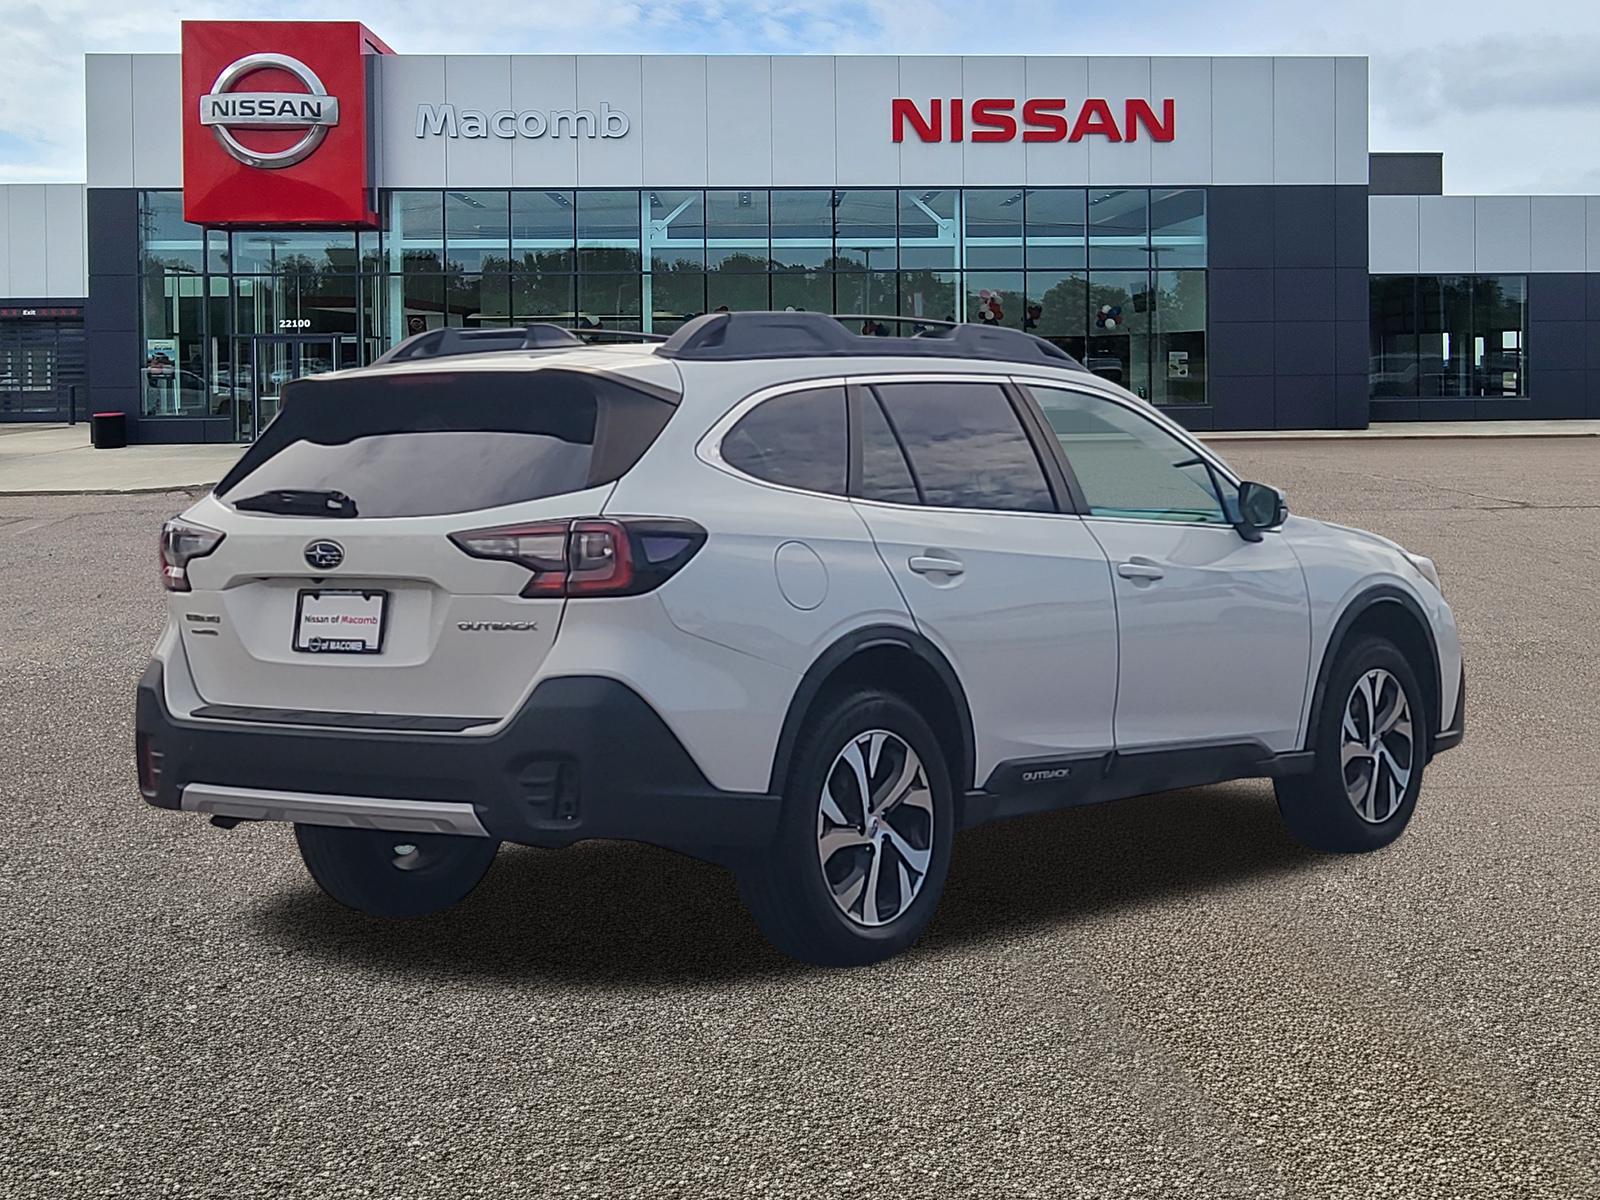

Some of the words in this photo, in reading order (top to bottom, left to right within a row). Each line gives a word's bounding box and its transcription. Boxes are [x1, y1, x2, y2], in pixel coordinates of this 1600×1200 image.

[211, 100, 322, 117] NISSAN
[415, 102, 630, 139] Macomb
[892, 98, 1175, 143] NISSAN
[279, 319, 311, 328] 22100
[304, 615, 329, 623] Nissan
[331, 615, 340, 623] of
[341, 615, 378, 625] Macomb
[457, 621, 538, 631] OUTBACK
[329, 641, 363, 651] MACOMB
[1022, 768, 1070, 781] OUTBACK
